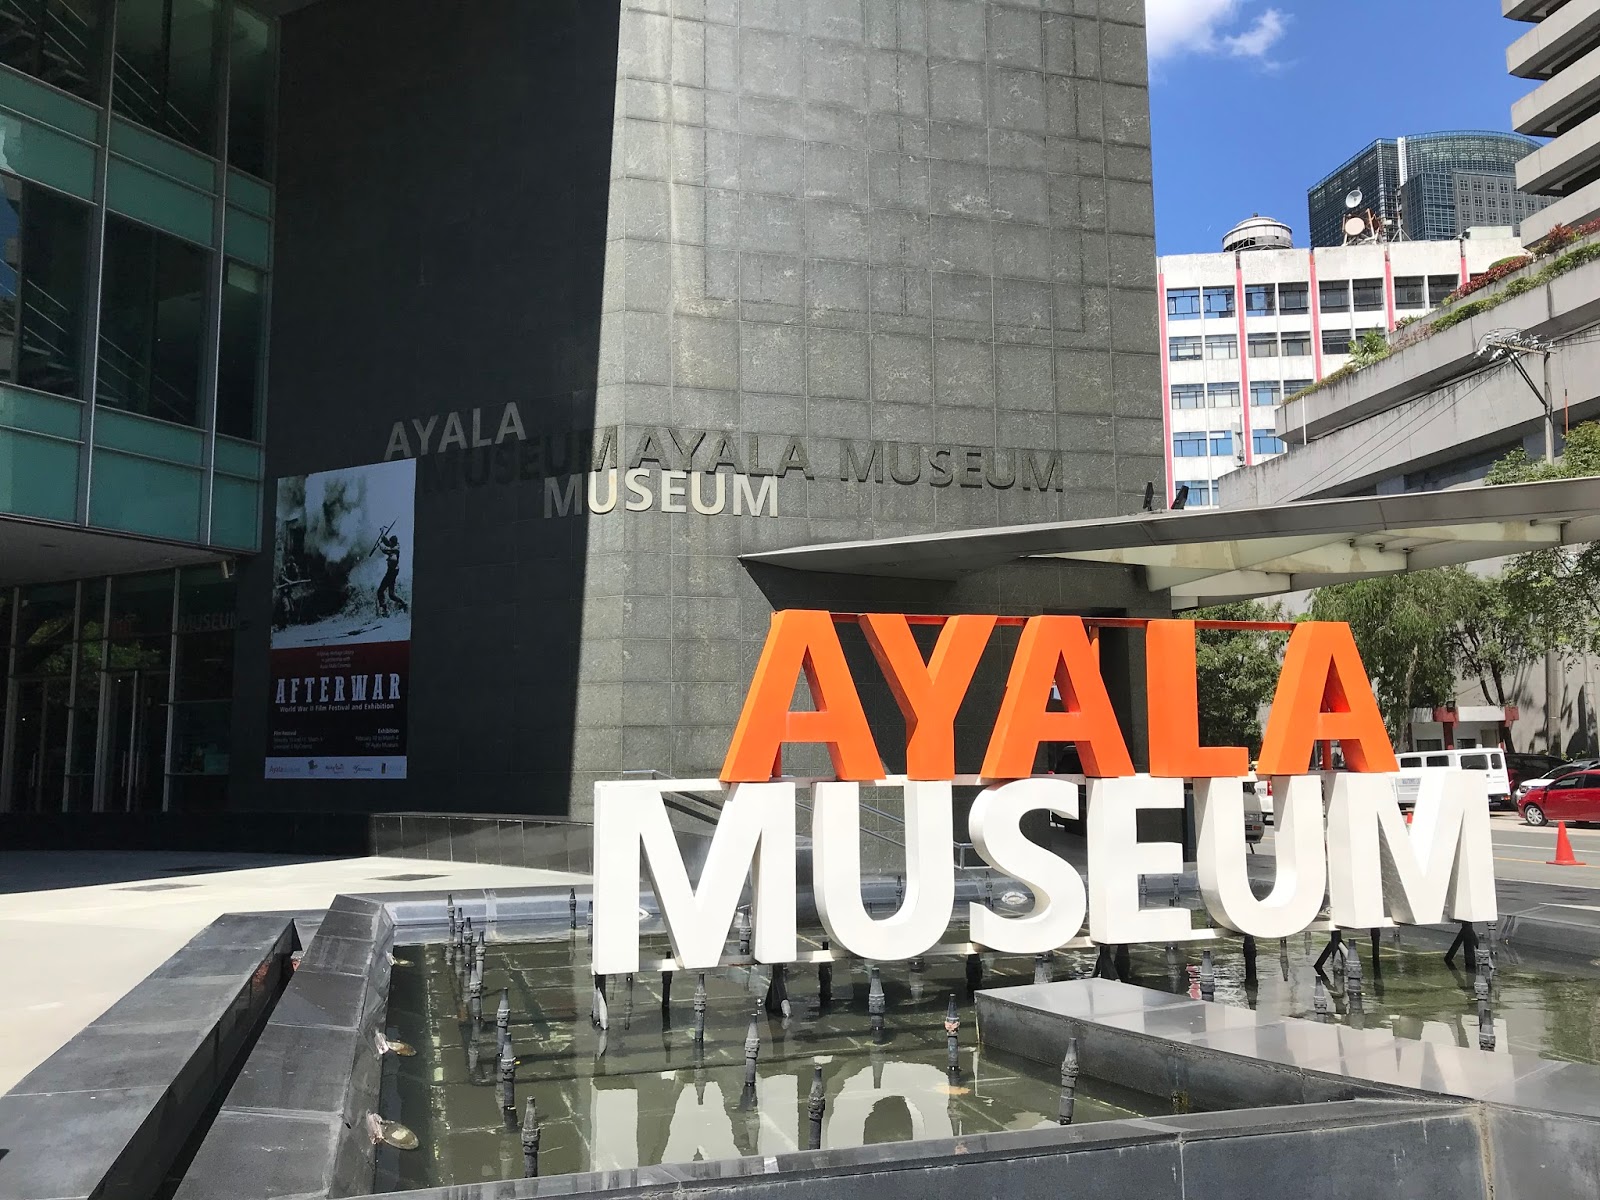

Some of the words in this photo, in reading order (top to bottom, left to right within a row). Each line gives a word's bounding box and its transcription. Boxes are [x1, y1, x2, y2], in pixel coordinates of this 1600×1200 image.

[383, 401, 526, 462] AYALA
[629, 428, 815, 481] AYALA
[839, 439, 1064, 492] MUSEUM
[543, 466, 778, 519] MUSEUM
[279, 705, 296, 713] World
[315, 704, 328, 712] Film
[328, 703, 350, 712] Festival
[351, 703, 363, 711] and
[364, 702, 394, 710] Exhibition
[719, 609, 1398, 783] AYALA
[592, 769, 1498, 975] MUSEUM
